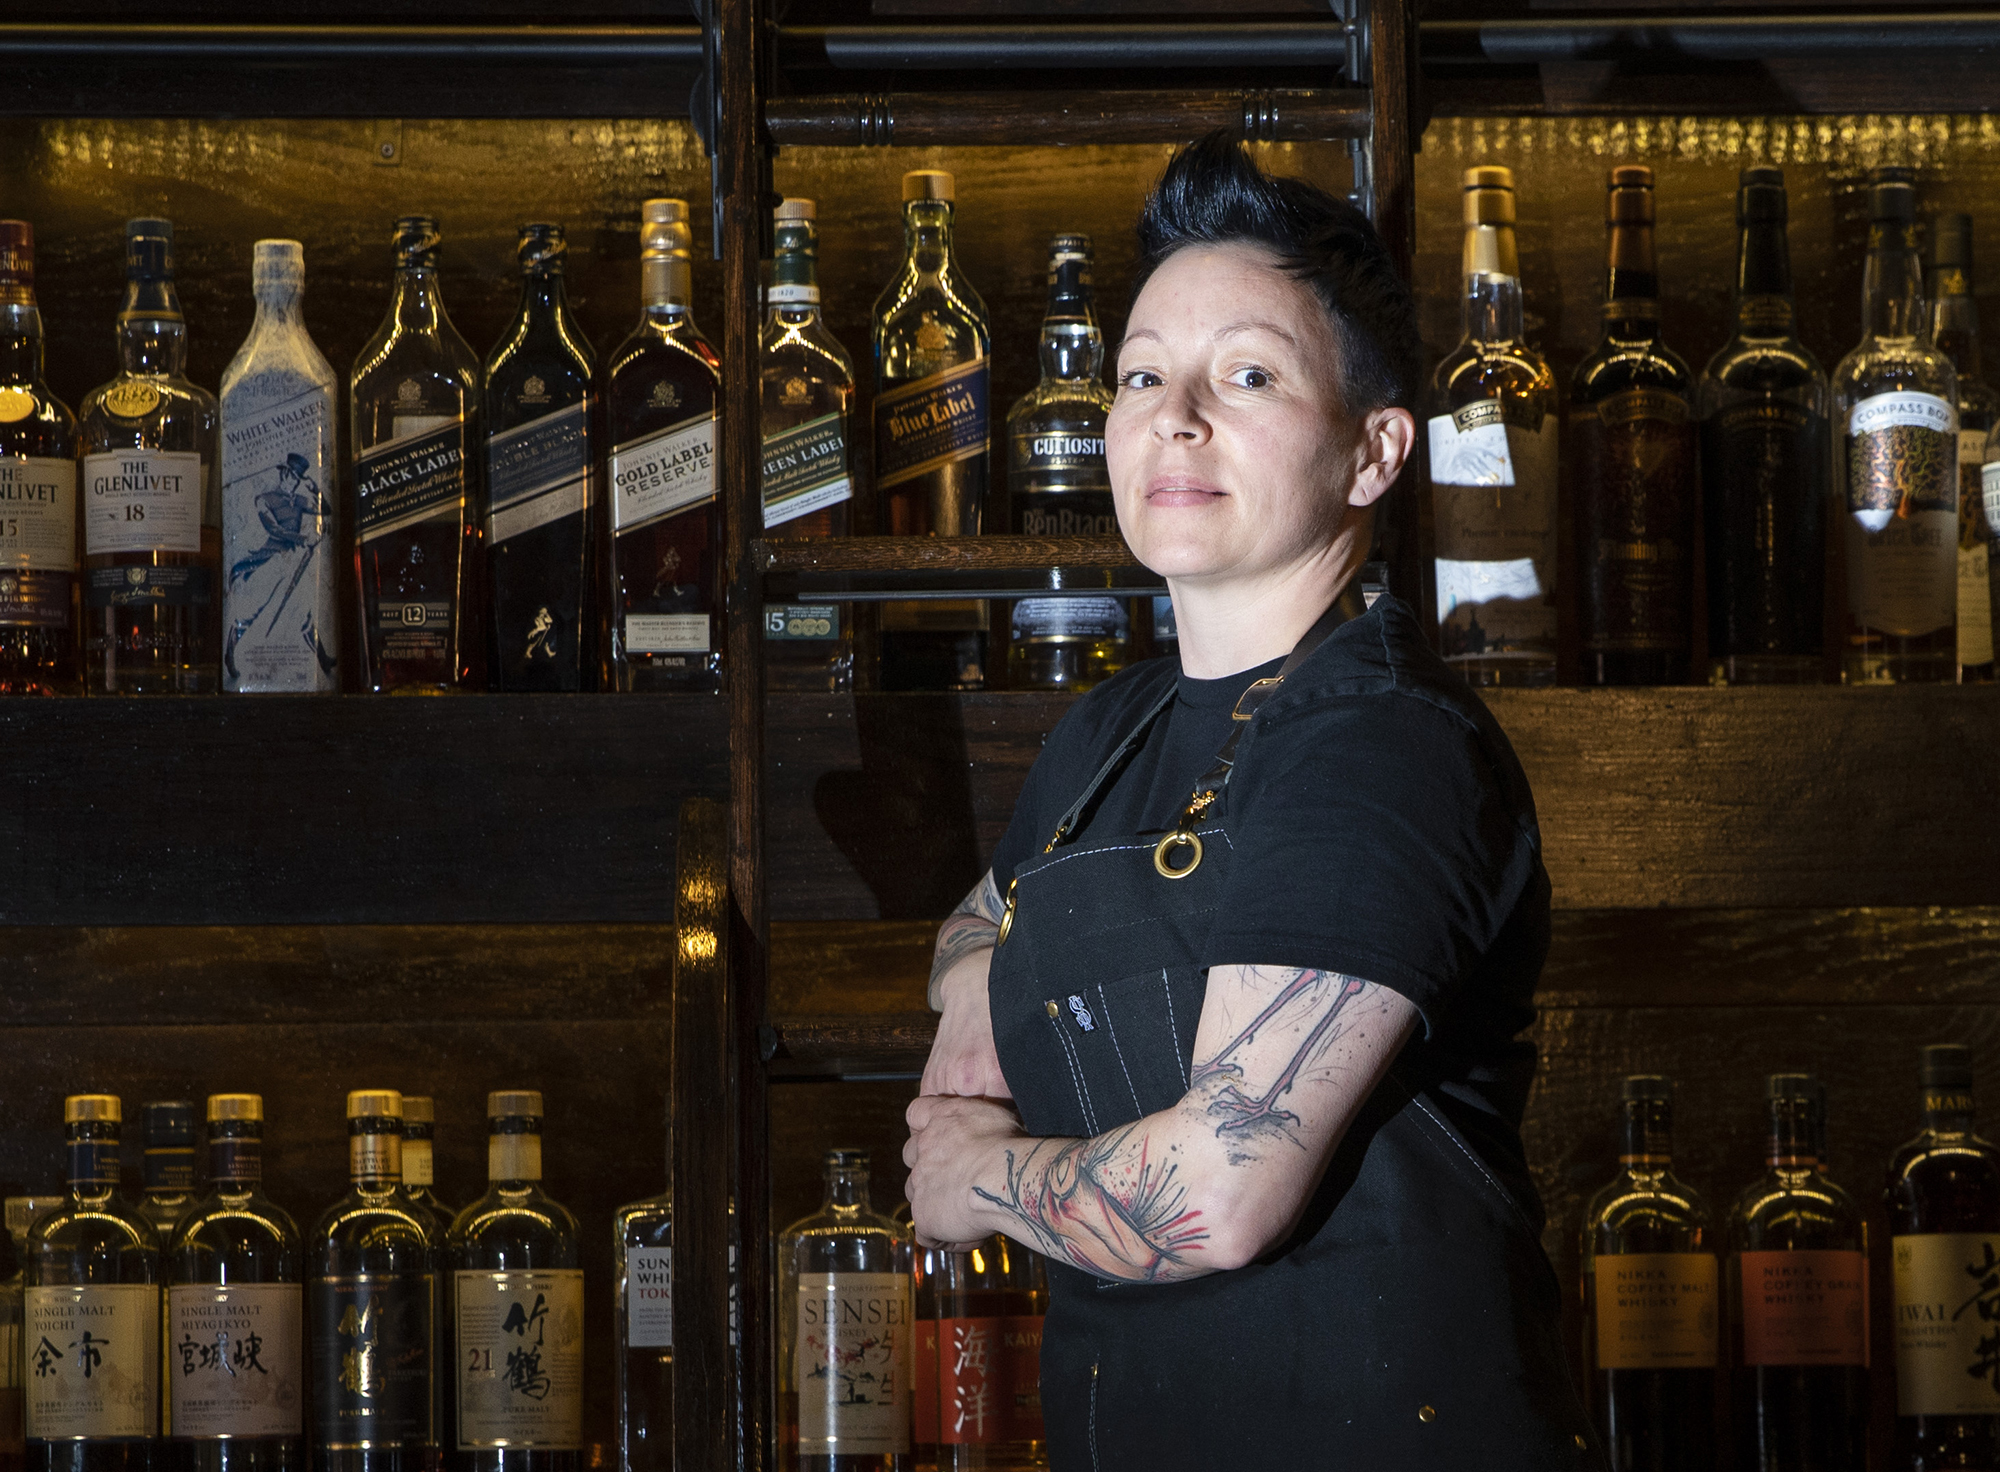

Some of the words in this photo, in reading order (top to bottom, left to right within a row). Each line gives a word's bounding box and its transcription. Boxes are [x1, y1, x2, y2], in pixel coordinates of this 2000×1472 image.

[226, 421, 271, 446] WHITE
[271, 400, 327, 428] WALKER
[889, 412, 930, 441] Blue
[926, 391, 976, 427] Label
[1857, 402, 1924, 425] COMPASS
[1928, 405, 1951, 423] BOX
[121, 461, 149, 475] THE
[370, 455, 408, 477] JOHNNIE
[615, 462, 659, 487] GOLD
[660, 441, 714, 471] LABEL
[94, 474, 184, 497] GLENLIVET
[358, 466, 413, 498] BLACK
[625, 457, 711, 497] RESERVE
[124, 503, 146, 522] 18
[407, 607, 422, 622] 12
[638, 1258, 670, 1270] SUN
[638, 1272, 670, 1284] WHI
[638, 1287, 670, 1300] TOK
[34, 1306, 75, 1318] SINGLE
[80, 1305, 116, 1317] MALT
[181, 1306, 219, 1318] SINGLE
[227, 1304, 262, 1316] MALT
[805, 1298, 906, 1325] SENSEI
[1898, 1303, 1945, 1322] IWAI
[34, 1320, 75, 1332] YOICHI
[181, 1319, 251, 1331] MIYAGIKYO
[820, 1328, 868, 1338] WISKEY
[1003, 1332, 1041, 1347] KAIY
[31, 1331, 110, 1379] 余市
[468, 1347, 493, 1372] 21
[952, 1324, 998, 1439] 海洋
